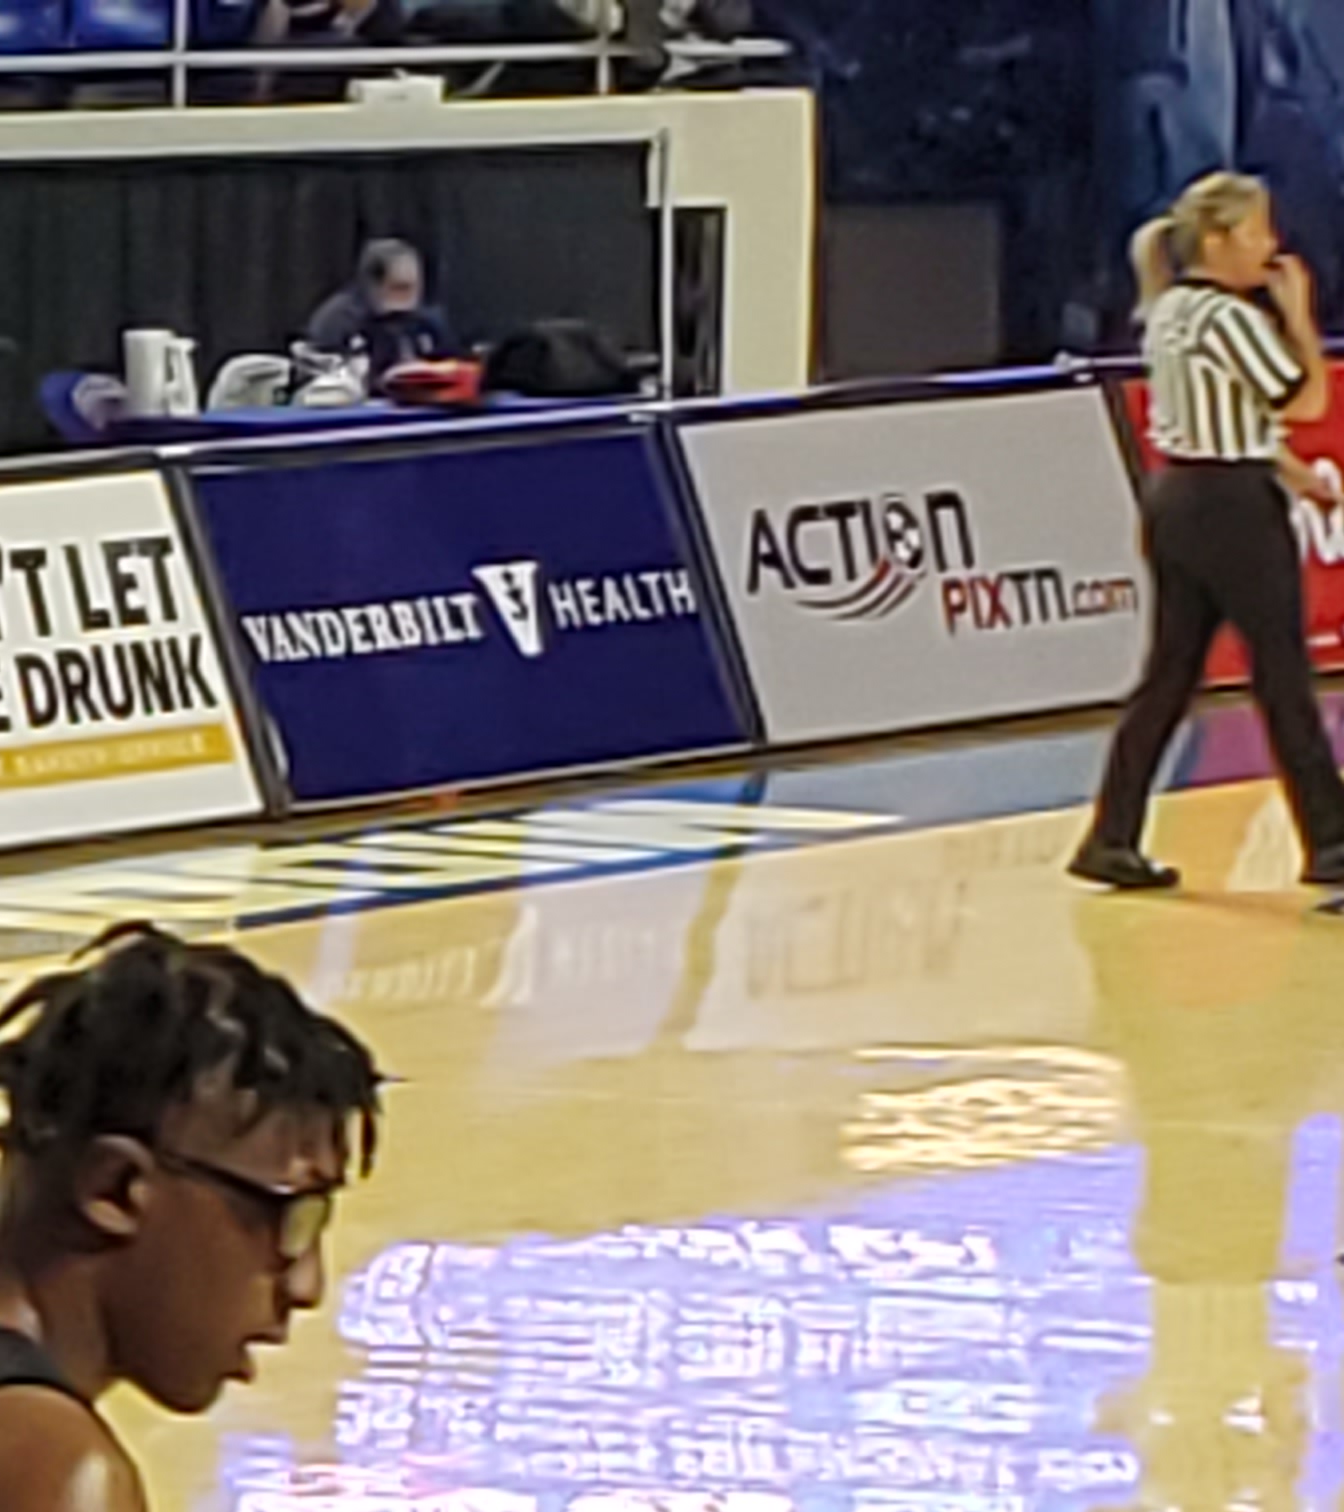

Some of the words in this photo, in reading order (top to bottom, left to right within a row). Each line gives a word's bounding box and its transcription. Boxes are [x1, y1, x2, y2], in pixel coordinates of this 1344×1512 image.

[62, 536, 180, 634] LET
[240, 592, 485, 664] VANDERBILT
[548, 568, 698, 631] HEALTH
[14, 634, 217, 730] DRUNK
